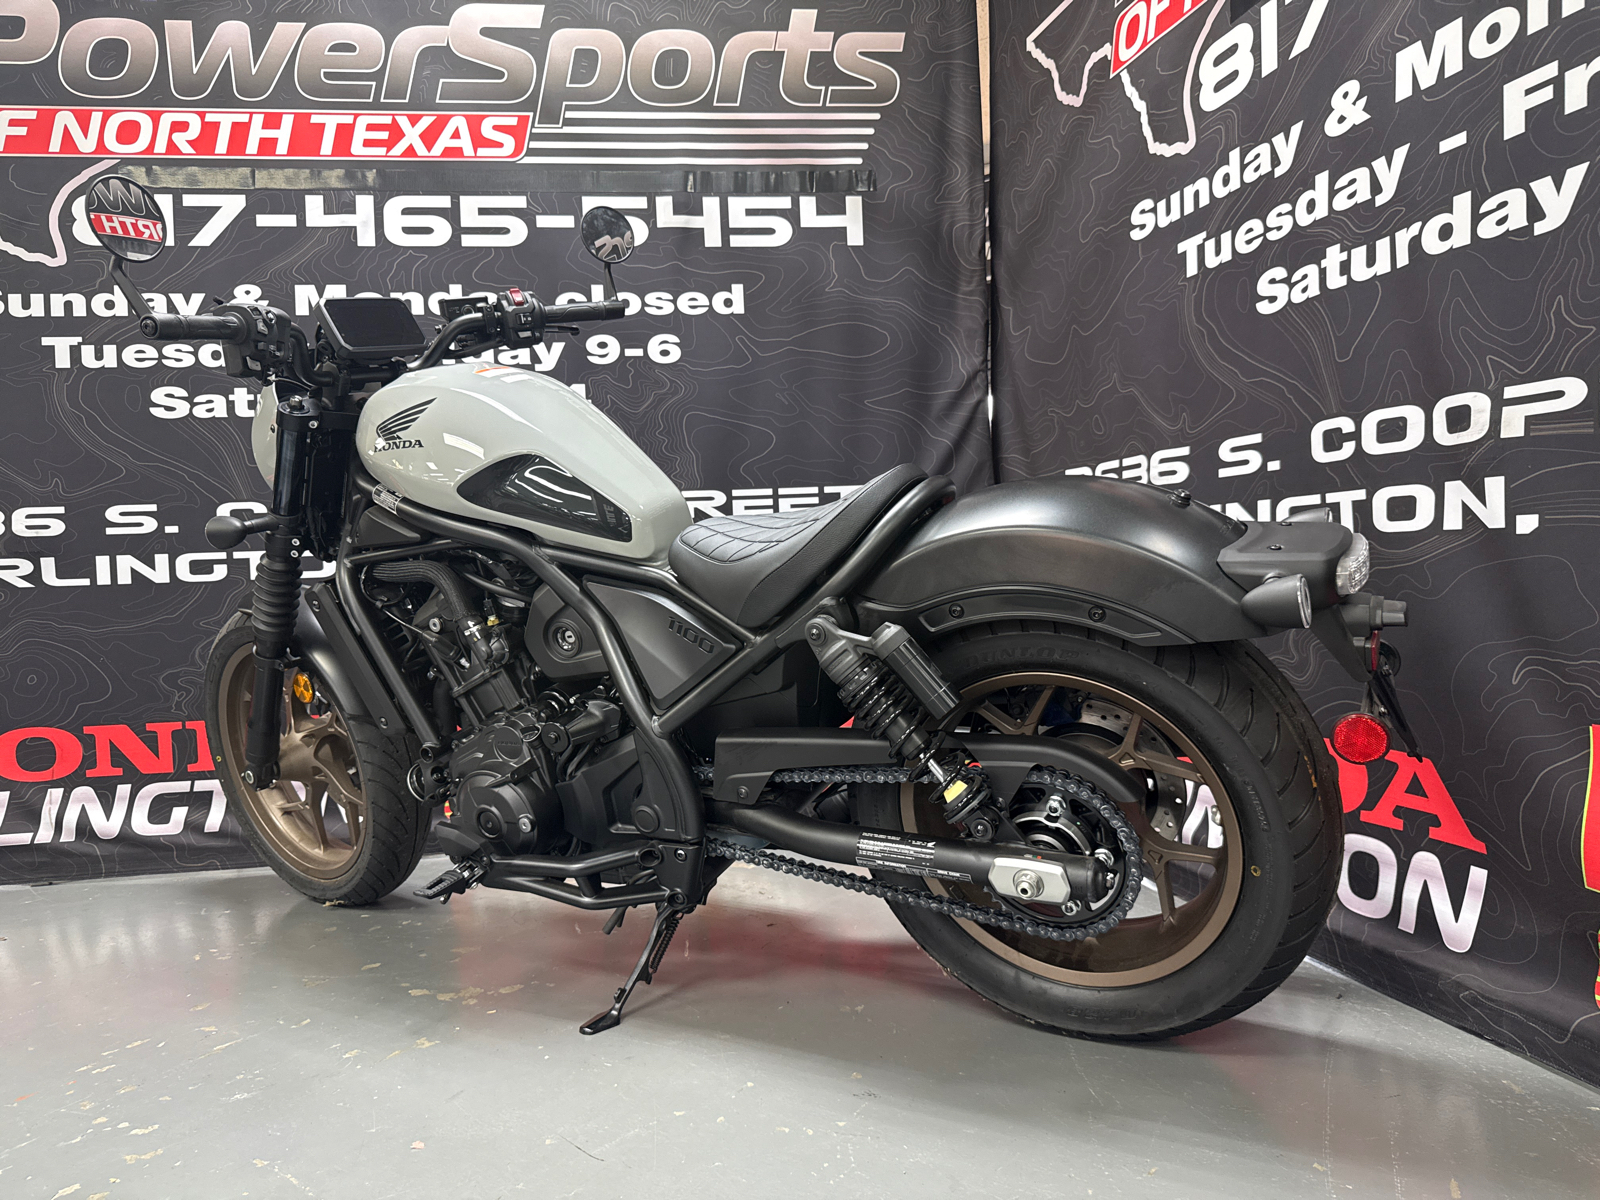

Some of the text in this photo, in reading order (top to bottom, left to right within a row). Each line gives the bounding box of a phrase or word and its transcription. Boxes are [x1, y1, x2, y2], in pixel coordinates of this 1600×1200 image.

[48, 110, 295, 156] NORTH
[310, 114, 519, 157] TEXAS
[1129, 120, 1304, 241] Sunday
[1324, 79, 1371, 137] &
[1177, 143, 1410, 278] Tuesday
[1255, 161, 1590, 315] Saturday
[0, 285, 206, 317] unday
[585, 333, 682, 365] 9-6
[1218, 433, 1281, 478] S.
[1310, 376, 1589, 464] COOP
[0, 506, 66, 537] 6
[105, 504, 180, 535] S.
[668, 616, 715, 654] 1100
